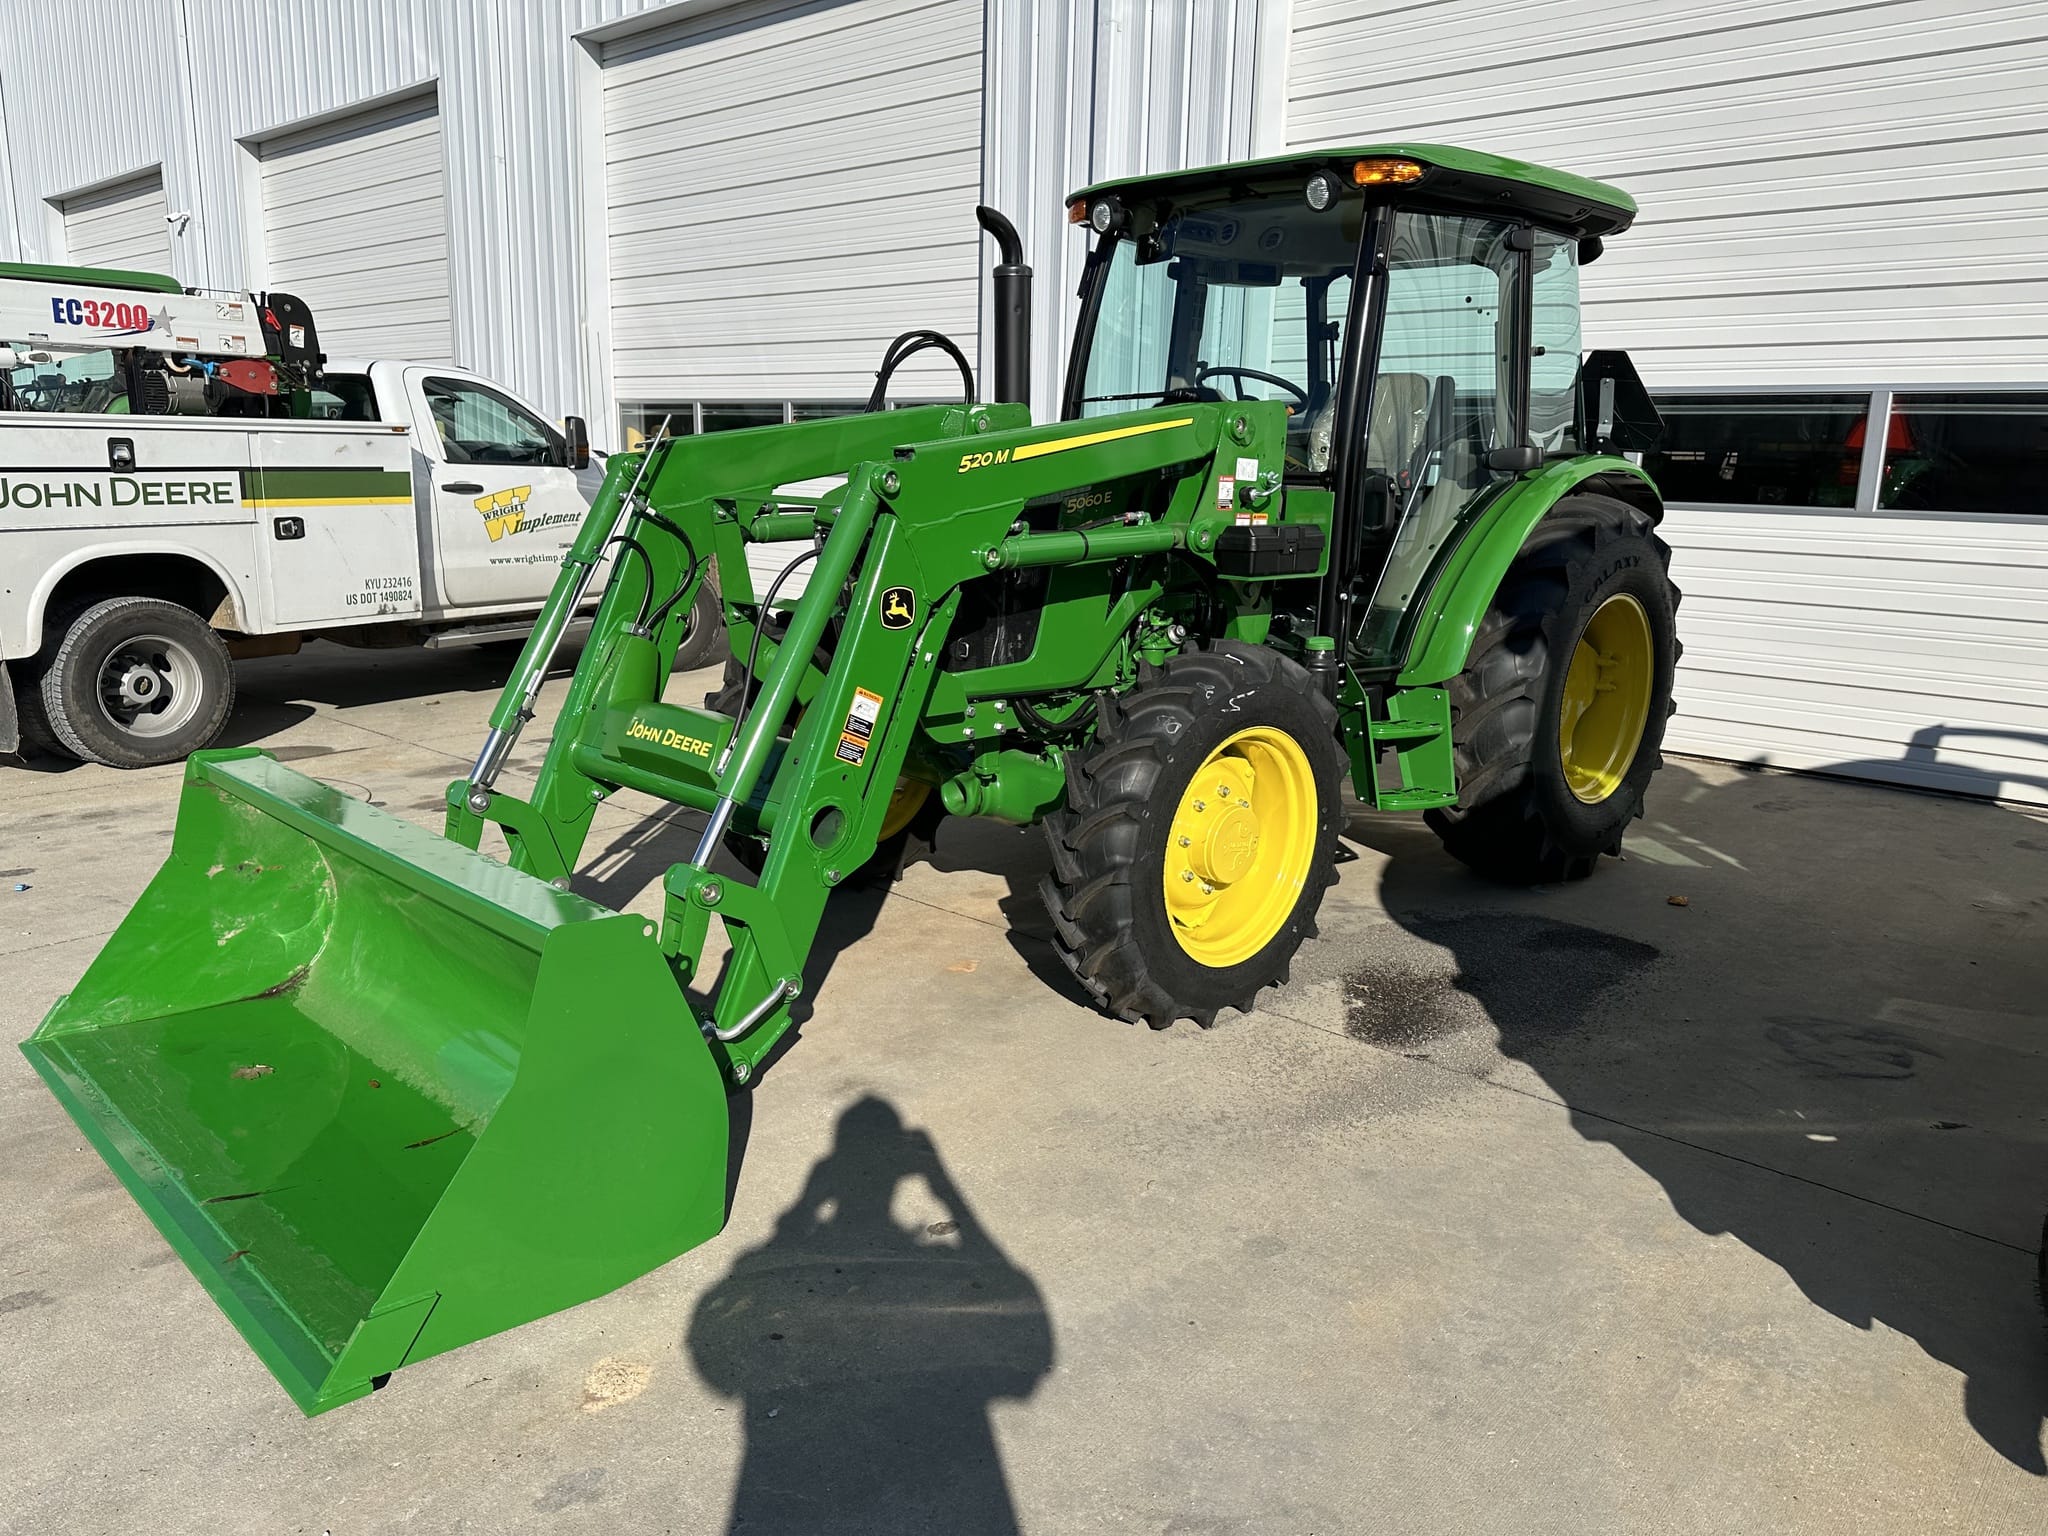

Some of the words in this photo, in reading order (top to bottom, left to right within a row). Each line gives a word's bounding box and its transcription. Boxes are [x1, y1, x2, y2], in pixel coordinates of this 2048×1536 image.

[51, 297, 149, 331] EC3200
[958, 451, 994, 473] 520
[994, 449, 1010, 464] M
[0, 478, 102, 508] JOHN
[110, 477, 234, 506] DEERE
[1066, 494, 1104, 513] 5060
[1103, 491, 1113, 504] E
[483, 503, 525, 520] WRIGHT
[513, 512, 581, 534] Implement
[490, 554, 566, 565] www.wrightimp.c
[365, 578, 381, 590] KYU
[383, 576, 412, 589] 232416
[346, 592, 358, 605] US
[361, 592, 377, 604] DOT
[380, 590, 412, 602] 1490824
[626, 720, 662, 742] JOHN
[662, 728, 713, 757] DEERE
